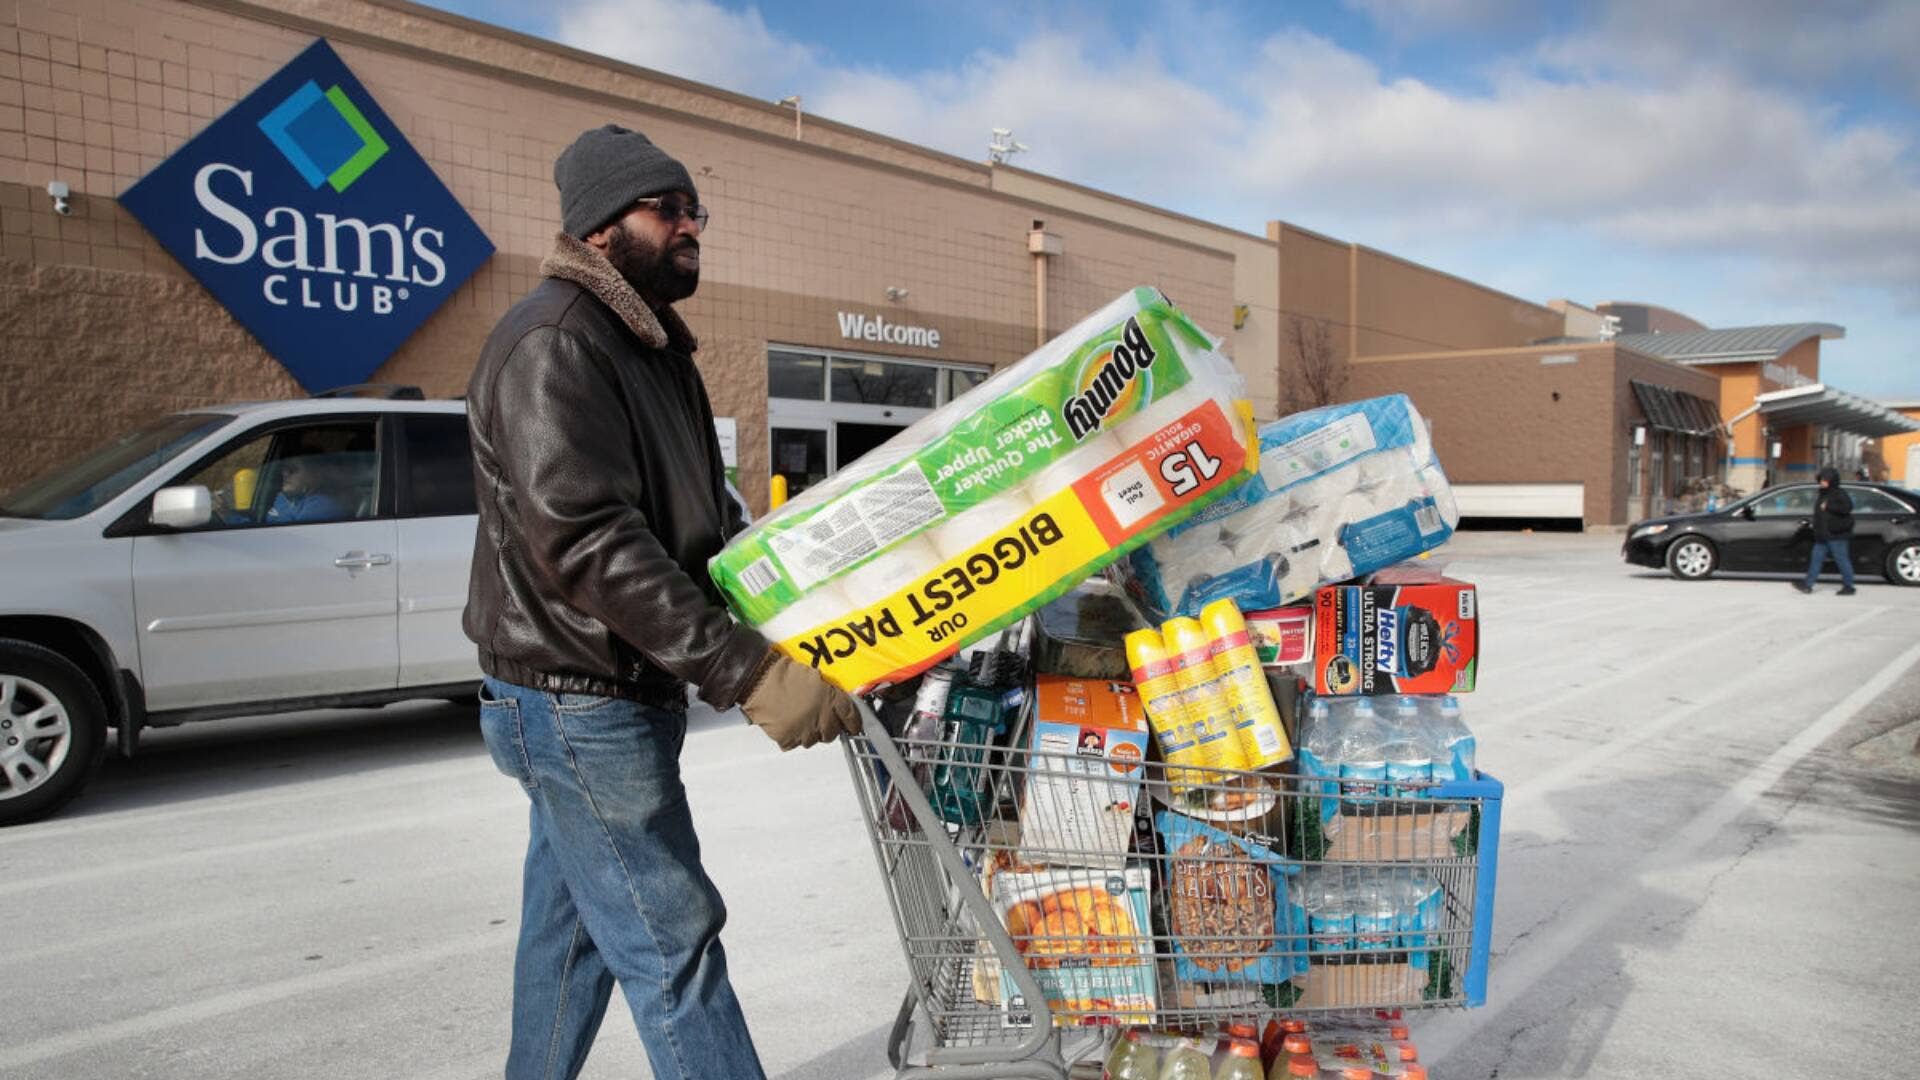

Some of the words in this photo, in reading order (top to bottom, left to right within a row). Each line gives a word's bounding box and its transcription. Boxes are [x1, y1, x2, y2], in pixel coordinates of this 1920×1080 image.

[194, 162, 447, 287] Sam's
[838, 311, 940, 348] Welcome
[1062, 315, 1156, 441] Bounty
[996, 410, 1052, 450] Picker
[1026, 428, 1063, 453] The
[1145, 423, 1203, 461] GIGANTIC
[1154, 422, 1184, 442] ROLLS
[934, 446, 993, 485] Upper
[954, 450, 1024, 496] Quicker
[1159, 440, 1222, 497] 15
[1118, 481, 1144, 499] Sheet
[906, 512, 1064, 626] BIGGEST
[926, 612, 967, 643] OUR
[1364, 591, 1374, 633] ULTRA
[799, 607, 903, 669] PACK
[1378, 611, 1396, 670] Hefty
[1364, 635, 1374, 689] STRONG
